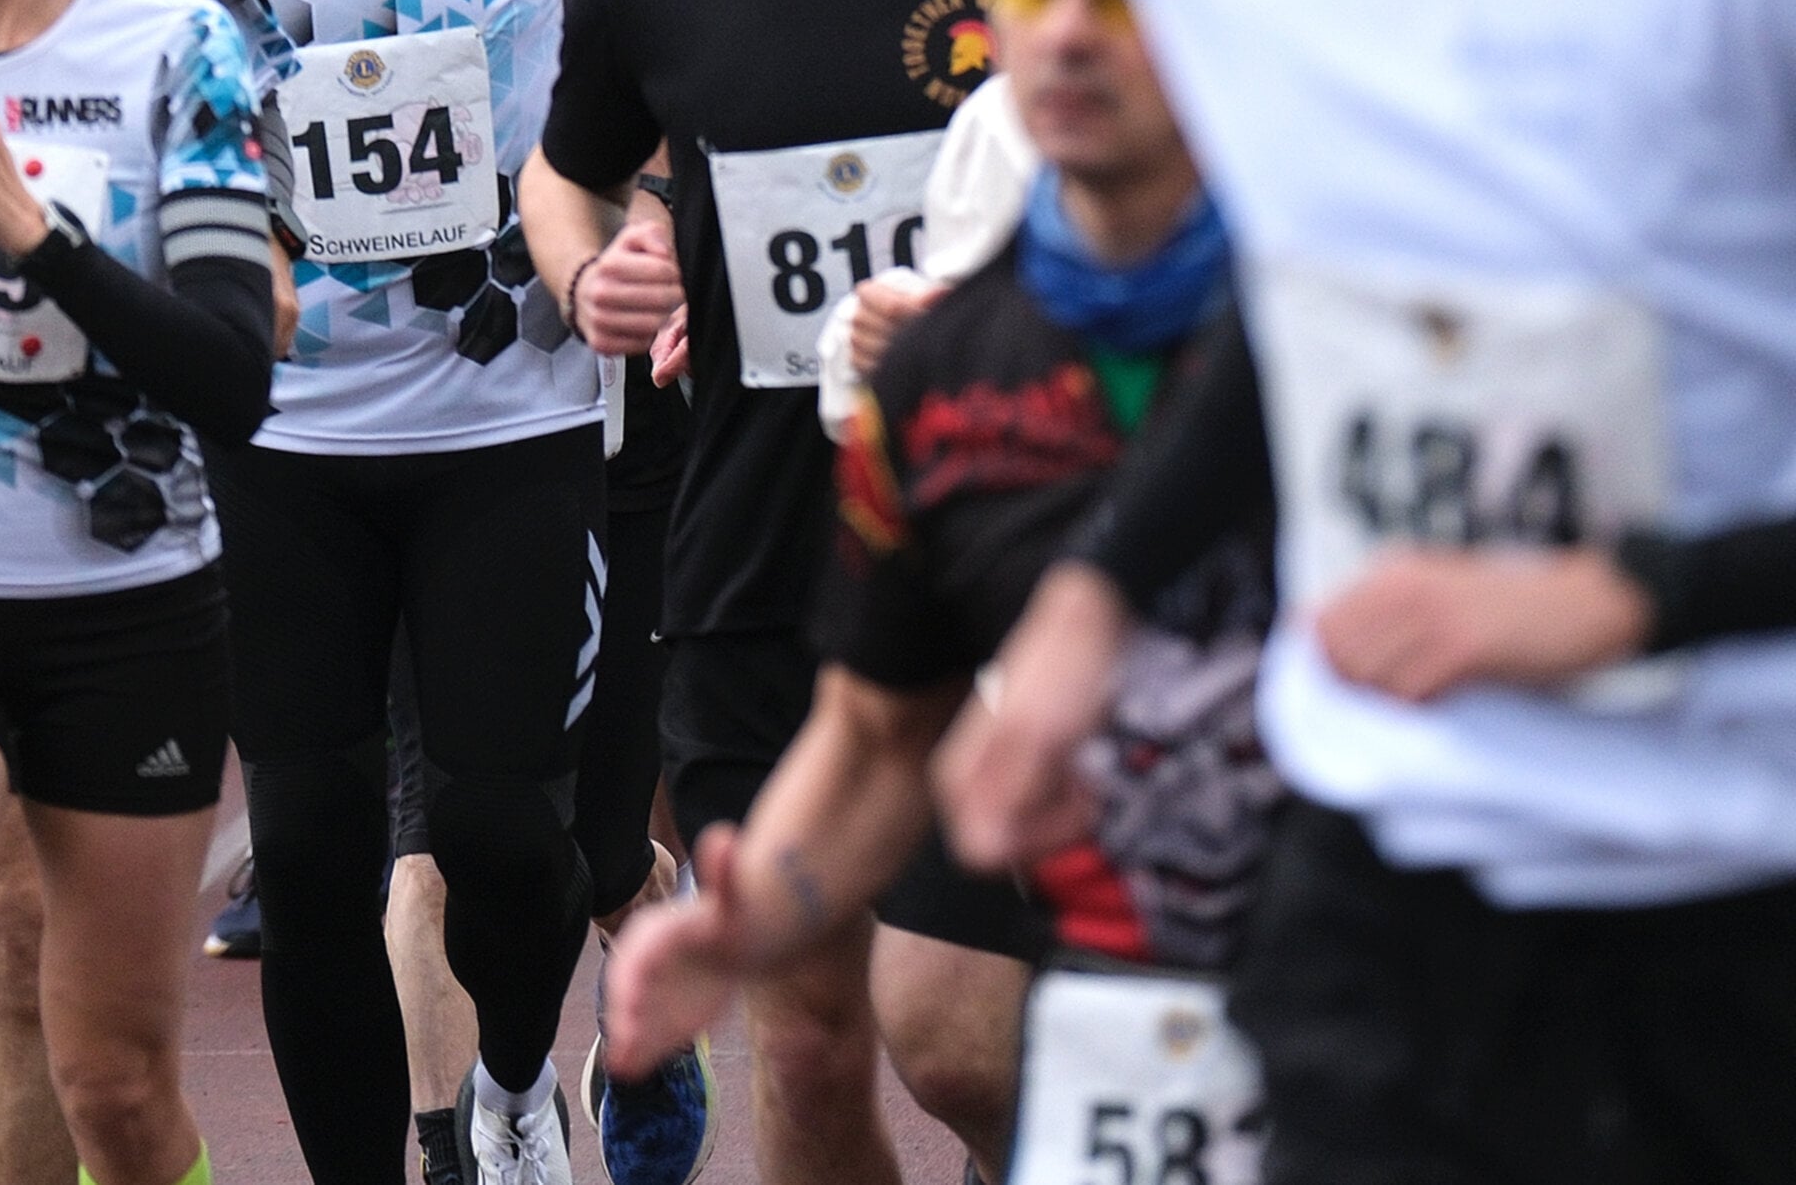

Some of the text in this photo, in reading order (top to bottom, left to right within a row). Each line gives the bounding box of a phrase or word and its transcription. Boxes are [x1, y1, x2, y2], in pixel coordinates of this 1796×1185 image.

[20, 96, 121, 125] RUNNERS
[292, 106, 464, 200] 154
[310, 223, 468, 255] SCHWEINELAUF
[1089, 1099, 1266, 1185] 58
